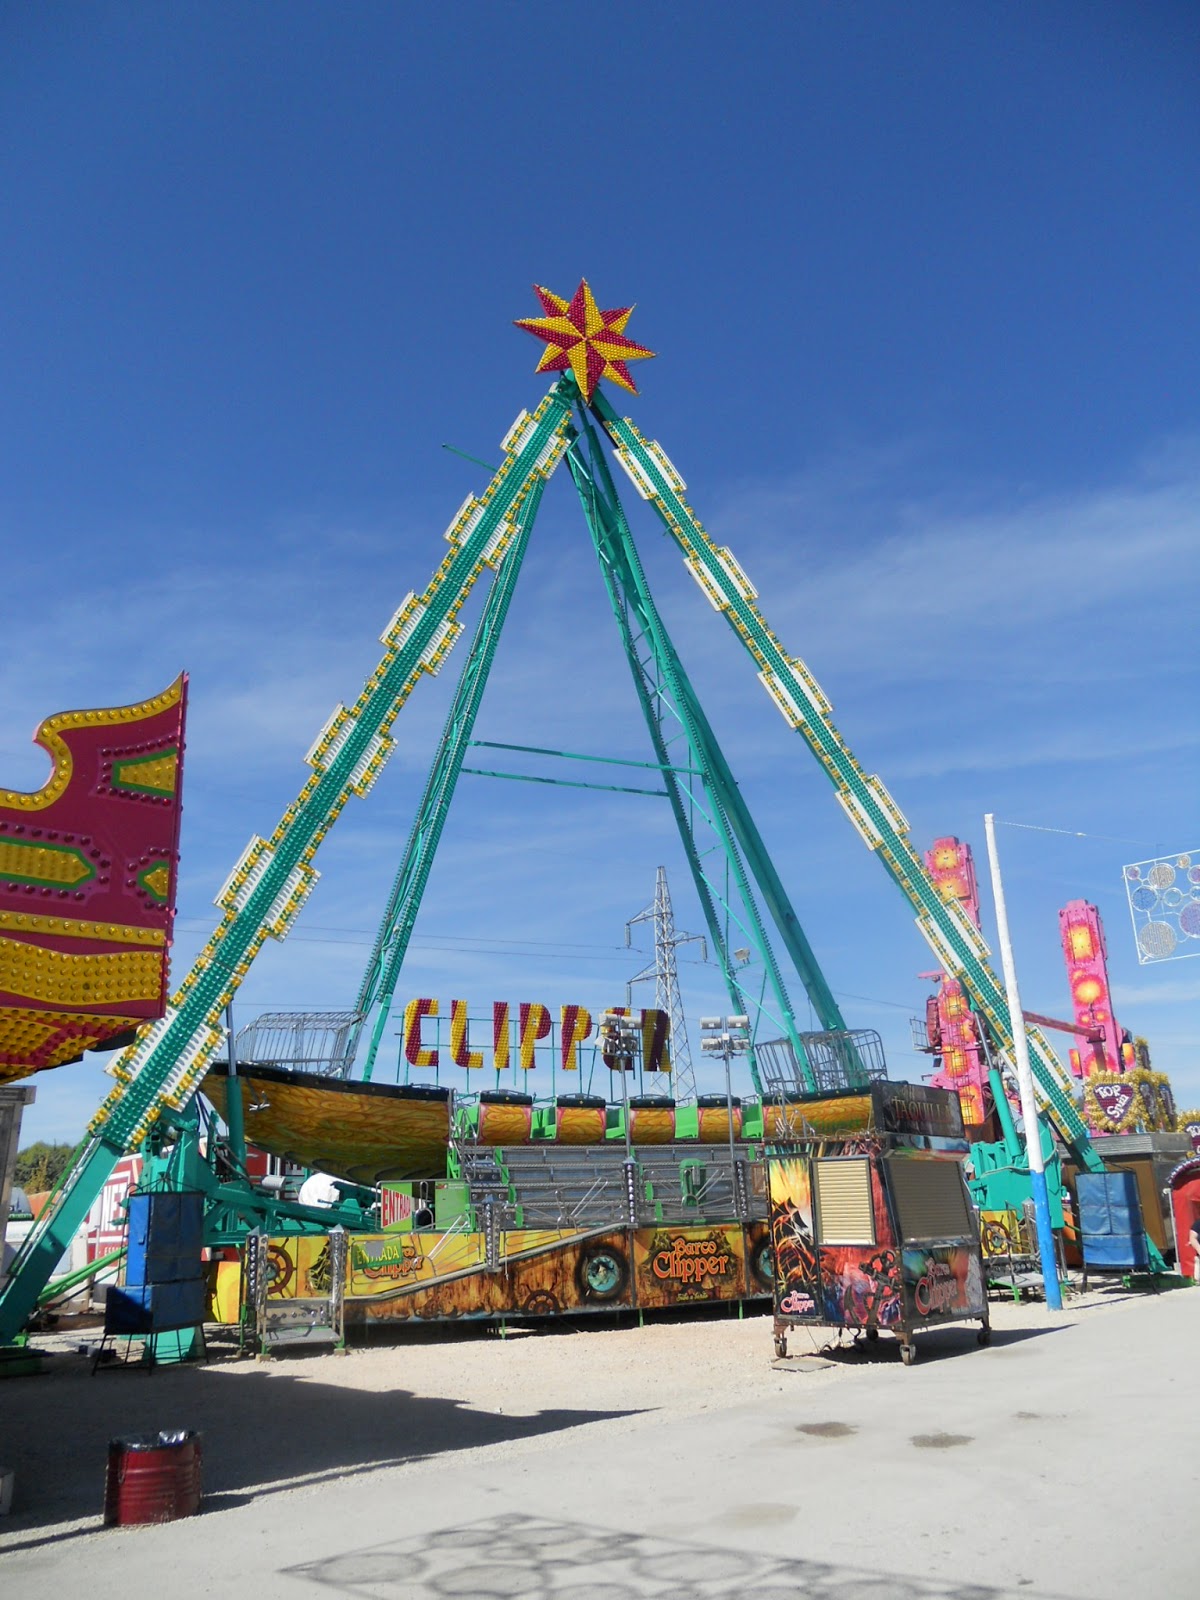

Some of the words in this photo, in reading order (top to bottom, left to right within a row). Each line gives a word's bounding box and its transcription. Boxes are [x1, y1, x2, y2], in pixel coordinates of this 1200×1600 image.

[1094, 1085, 1121, 1099] TOP
[1106, 1094, 1130, 1119] Spin
[356, 1245, 400, 1265] ENADA
[671, 1237, 717, 1256] Barco
[653, 1251, 729, 1283] Clipper
